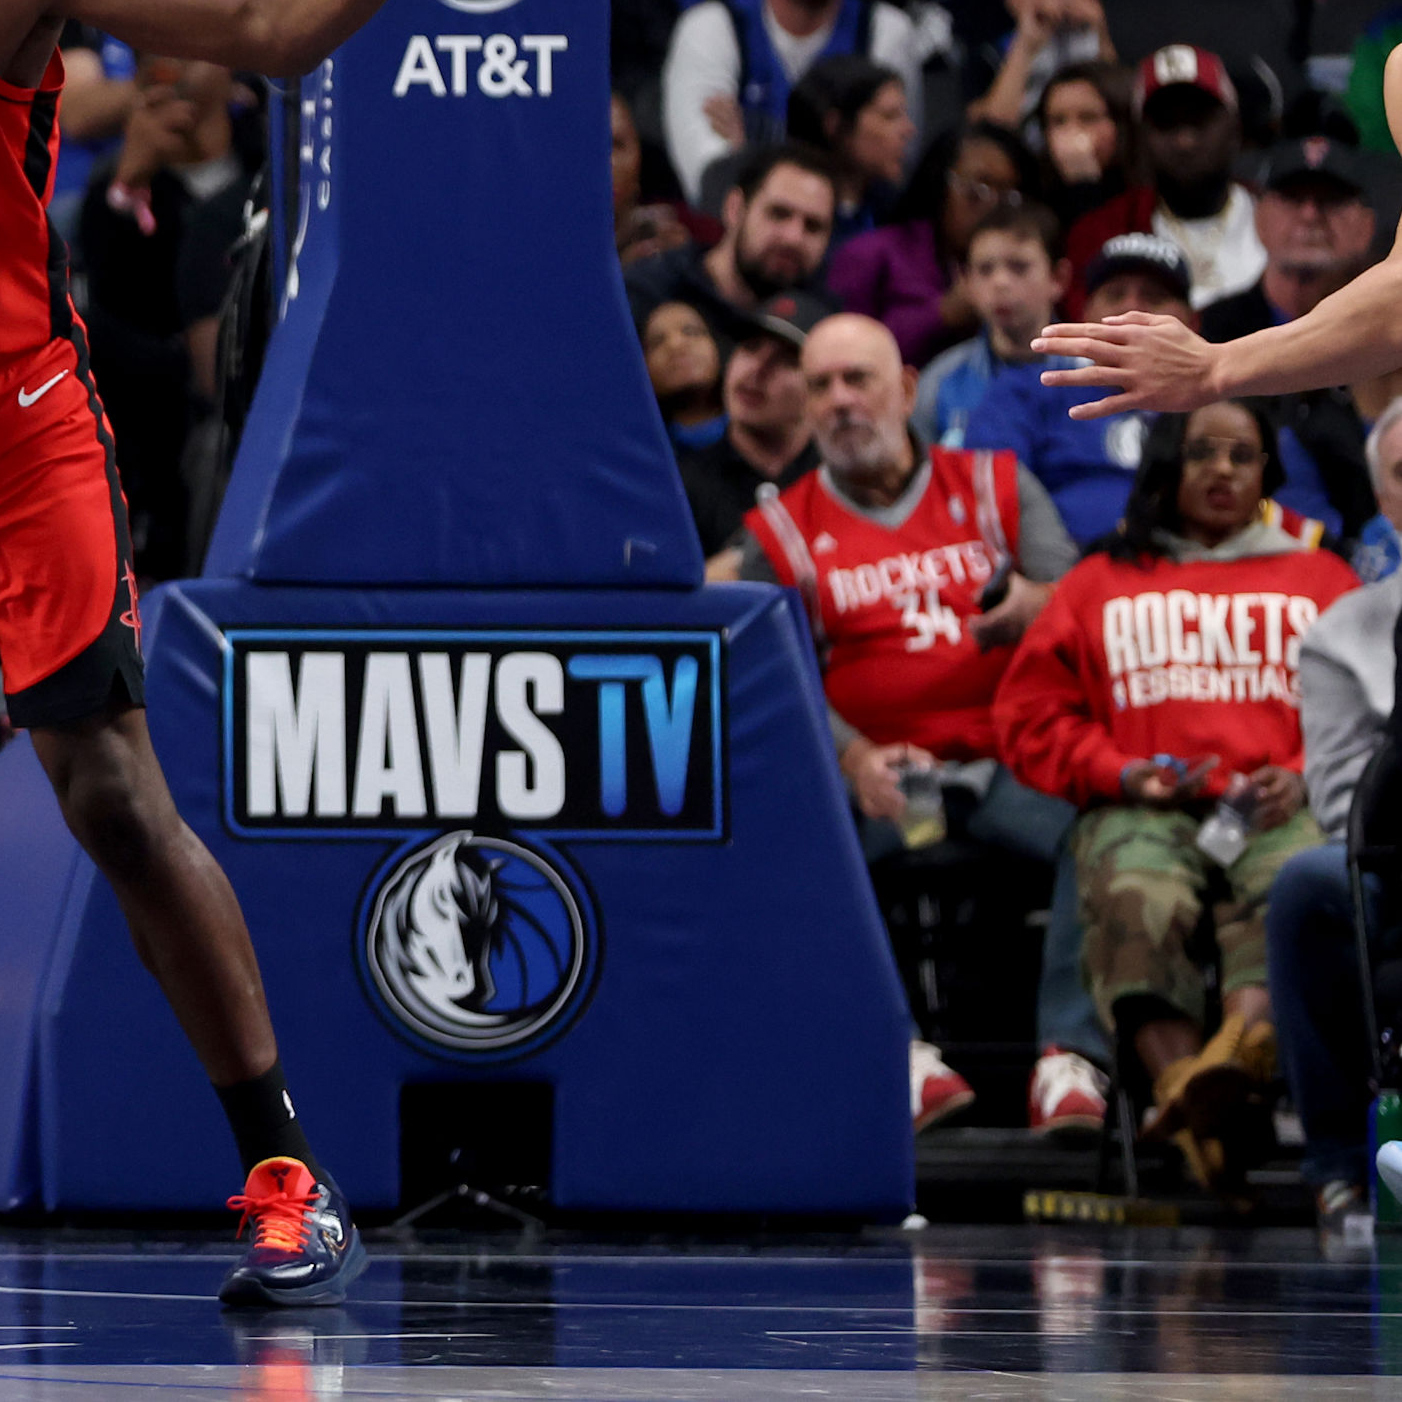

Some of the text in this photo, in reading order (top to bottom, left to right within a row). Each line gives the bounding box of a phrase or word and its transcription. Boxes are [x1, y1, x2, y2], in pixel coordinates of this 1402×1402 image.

[393, 34, 568, 98] AT&T
[828, 540, 993, 616] ROCKETS
[893, 586, 963, 653] 34
[1102, 589, 1319, 678] ROCKETS
[246, 651, 698, 821] MAVS TV
